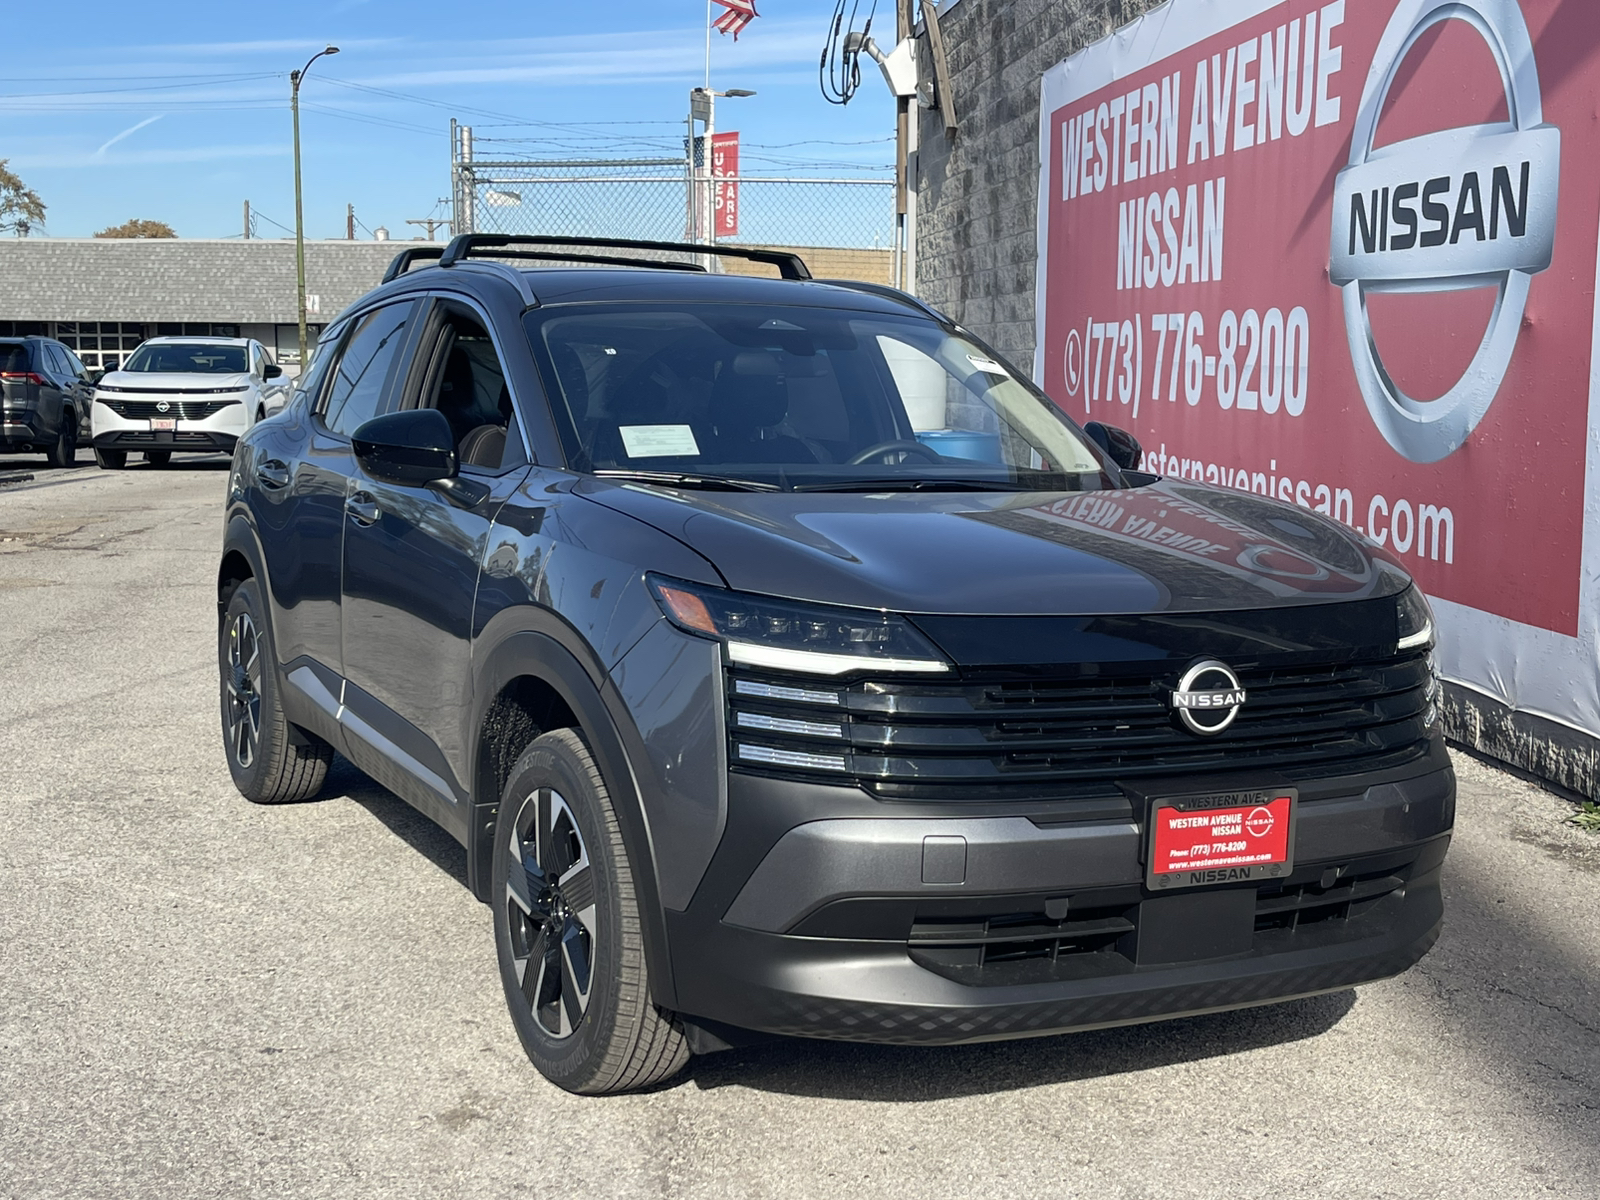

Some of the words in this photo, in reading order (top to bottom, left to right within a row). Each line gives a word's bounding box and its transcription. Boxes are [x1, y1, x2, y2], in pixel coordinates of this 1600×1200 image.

[1062, 70, 1181, 201] WESTERN
[1187, 3, 1345, 165] AVENUE
[726, 170, 735, 228] CARS
[1349, 161, 1530, 256] NISSAN
[1116, 177, 1226, 290] NISSAN
[1084, 315, 1142, 418] (773)
[1151, 306, 1309, 417] 776-8200
[1175, 691, 1246, 707] NISSAN
[1187, 794, 1238, 809] WESTERN
[1240, 792, 1262, 805] AVE
[1169, 816, 1210, 829] WESTERN
[1210, 813, 1243, 826] AVENUE
[1245, 818, 1275, 826] NISSAN
[1212, 825, 1242, 836] NISSAN
[1190, 845, 1211, 857] (773)
[1212, 841, 1247, 853] 776-8200
[1168, 853, 1272, 869] www.westernavenissan.com
[1190, 867, 1251, 884] NISSAN
